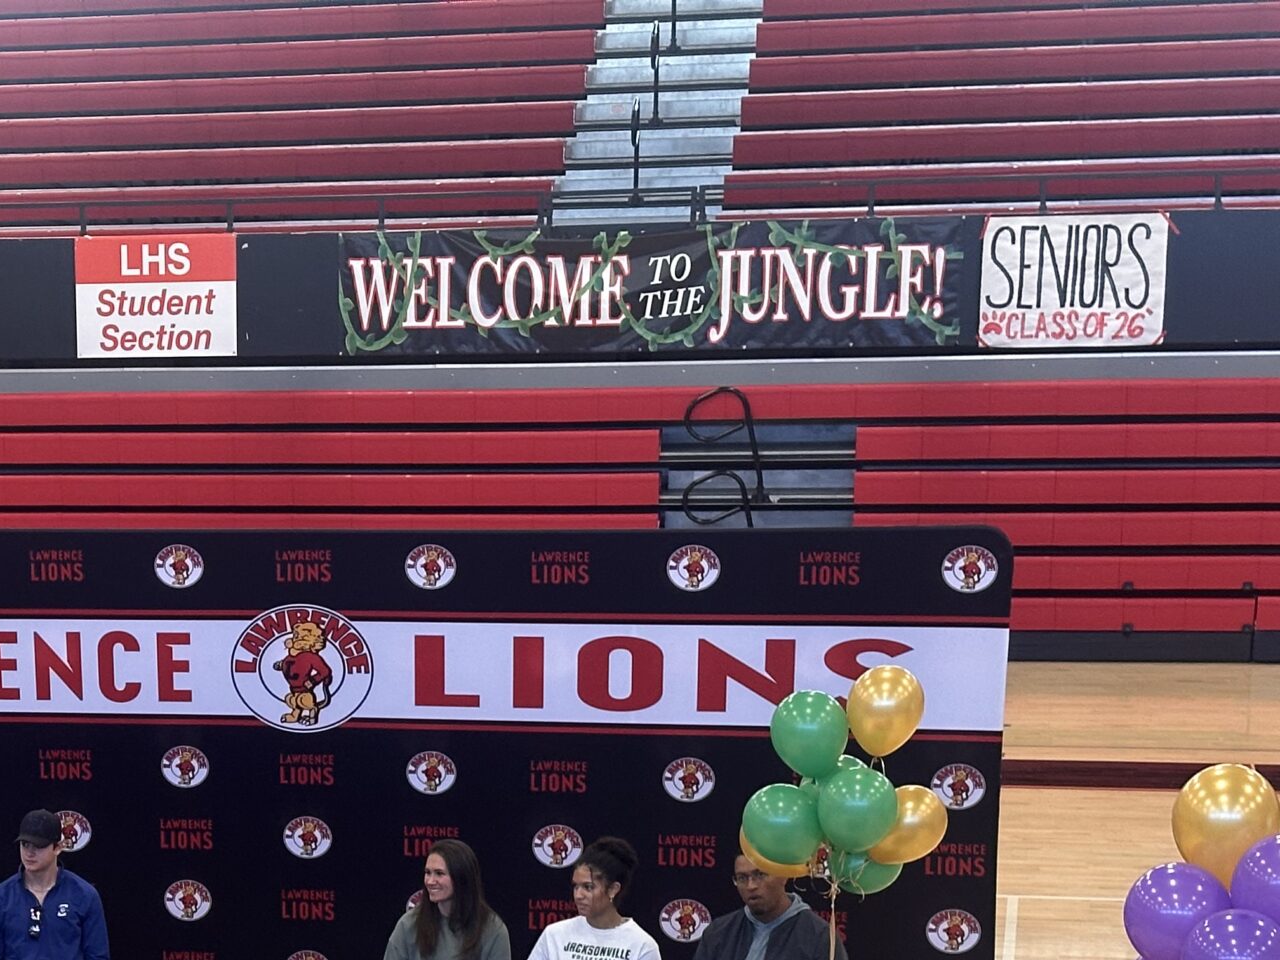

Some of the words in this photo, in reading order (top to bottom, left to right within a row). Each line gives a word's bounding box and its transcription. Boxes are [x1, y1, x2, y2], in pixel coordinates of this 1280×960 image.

[120, 242, 191, 276] LHS
[985, 222, 1152, 309] SENIORS
[649, 253, 692, 285] TO
[349, 254, 630, 331] WELCOME
[96, 288, 216, 317] Student
[638, 286, 706, 320] THE
[1005, 311, 1080, 340] CLASS
[1082, 311, 1110, 338] OF
[99, 323, 212, 352] Section
[30, 550, 83, 561] LAWRENCE
[275, 550, 332, 561] LAWRENCE
[531, 551, 590, 563] LAWRENCE
[800, 551, 861, 563] LAWRENCE
[31, 562, 84, 581] LIONS
[276, 562, 332, 582] LIONS
[531, 564, 590, 585] LIONS
[799, 565, 860, 585] LIONS
[235, 609, 370, 674] LAWRENCE
[39, 749, 92, 760] LAWRENCE
[280, 754, 334, 765] LAWRENCE
[40, 761, 93, 780] LIONS
[530, 760, 587, 772] LAWRENCE
[280, 766, 335, 786] LIONS
[531, 773, 587, 793] LIONS
[160, 819, 213, 830] LAWRENCE
[404, 825, 459, 837] LAWRENCE
[160, 831, 214, 850] LIONS
[404, 839, 432, 856] LIO
[658, 834, 716, 847] LAWRENCE
[658, 847, 716, 868] LIONS
[924, 856, 986, 877] LIONS
[281, 889, 335, 901] LAWRENCE
[282, 902, 335, 921] LIONS
[564, 942, 631, 960] JACKSONVILLE
